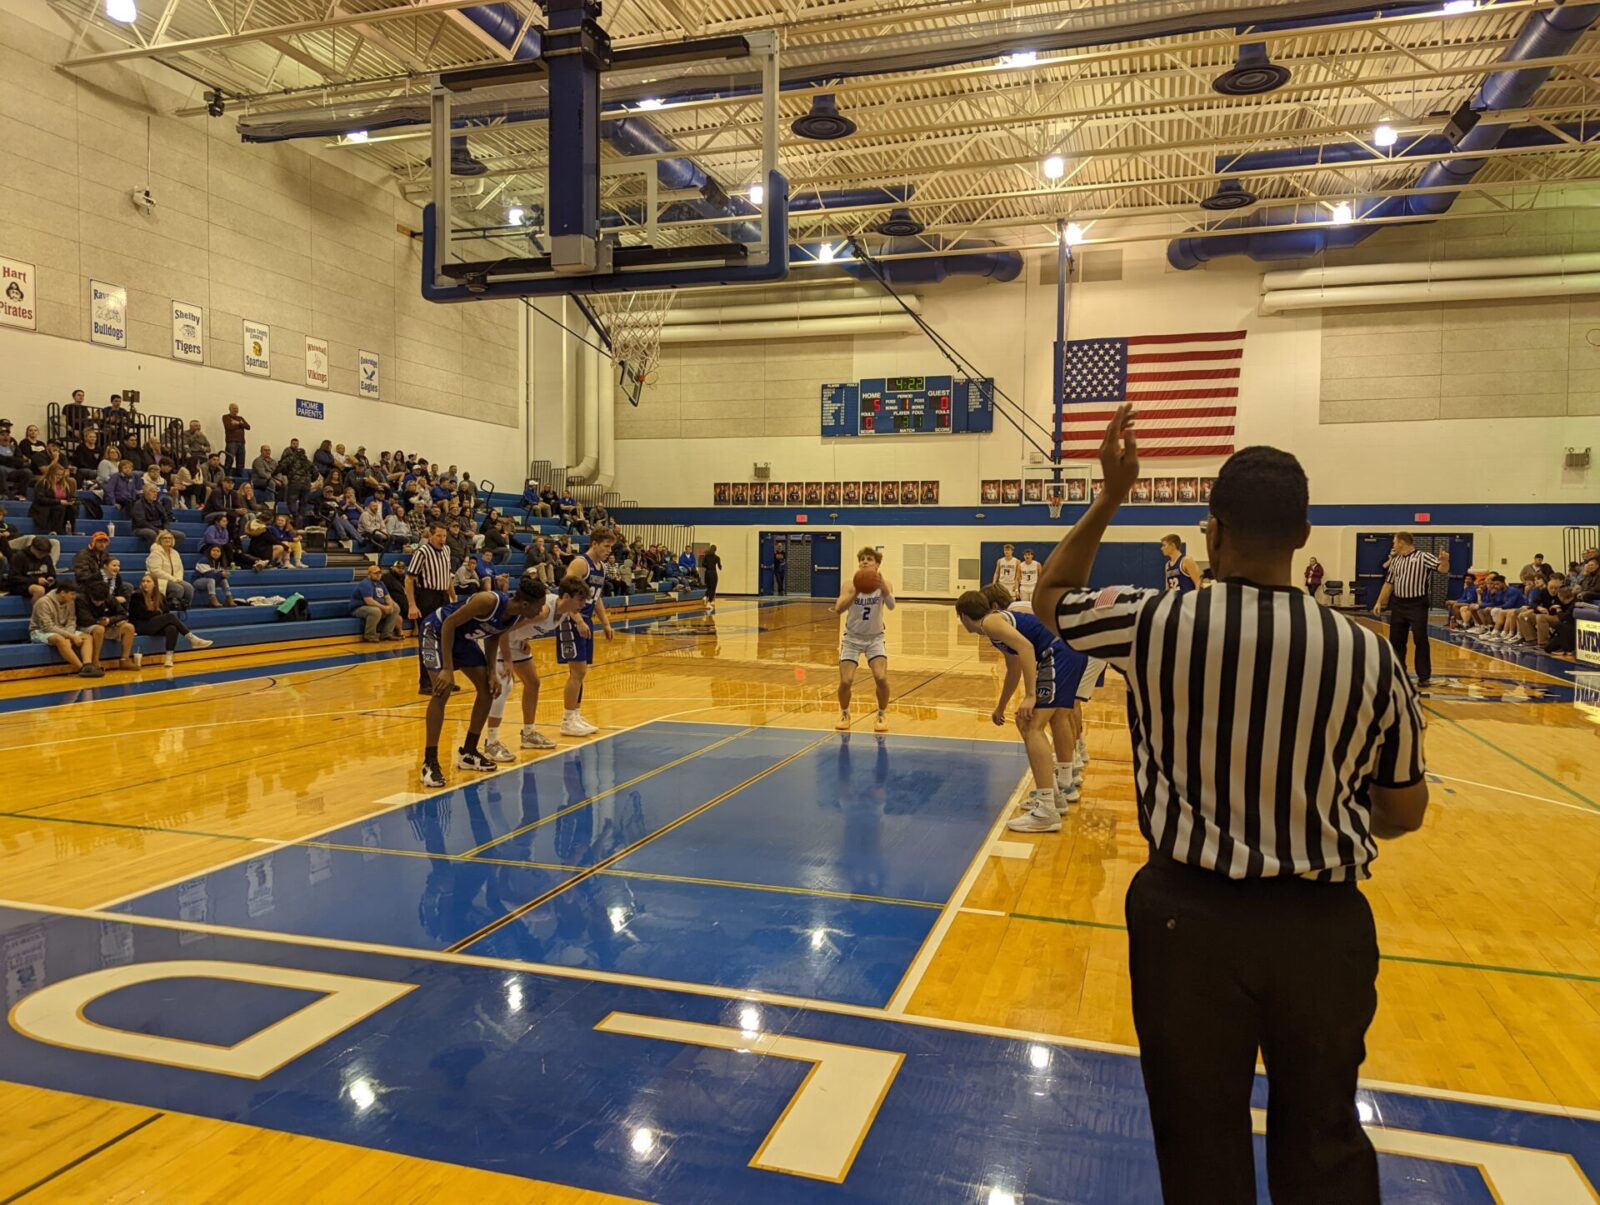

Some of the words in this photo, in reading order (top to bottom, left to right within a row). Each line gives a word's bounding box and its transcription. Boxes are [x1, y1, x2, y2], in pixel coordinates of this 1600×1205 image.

[2, 266, 27, 283] Hart
[0, 301, 33, 320] Pirates
[174, 309, 201, 326] Shelby
[94, 321, 124, 341] Bulldogs
[175, 339, 202, 355] Tigers
[246, 355, 268, 369] Spartans
[307, 369, 327, 384] Vikings
[895, 377, 923, 390] 4:22
[360, 380, 378, 393] Eagles
[927, 389, 950, 397] GUEST
[301, 400, 319, 411] HOME
[873, 399, 881, 412] 5
[940, 396, 949, 410] 0
[297, 407, 323, 419] PARENTS
[865, 416, 874, 430] 0
[862, 606, 871, 621] 2
